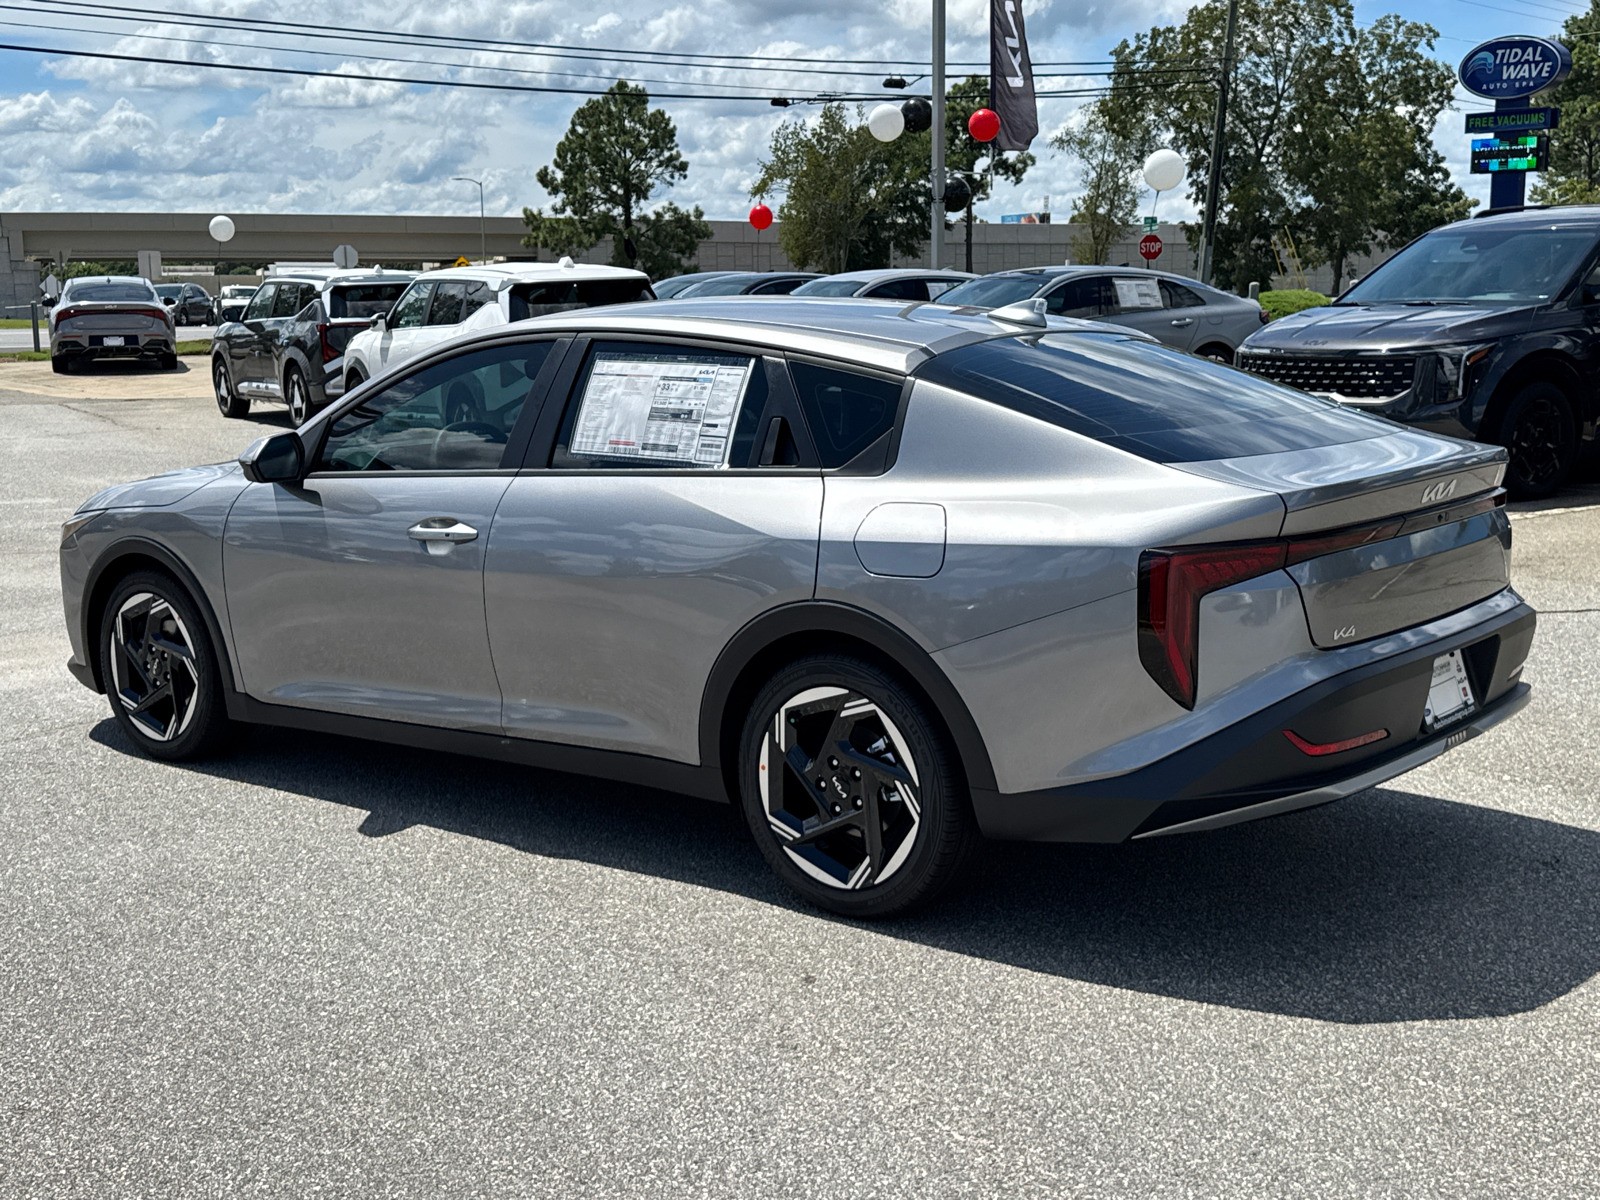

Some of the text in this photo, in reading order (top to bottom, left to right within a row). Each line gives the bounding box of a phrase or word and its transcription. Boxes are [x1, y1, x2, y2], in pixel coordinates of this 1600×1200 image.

[1495, 45, 1543, 65] TIDAL
[1502, 61, 1553, 80] WAVE
[1481, 82, 1508, 90] AUTO
[1468, 112, 1545, 128] FREE VACUUMS
[1140, 241, 1162, 254] STOP
[660, 382, 671, 391] 33
[1420, 478, 1457, 504] KIA
[1333, 624, 1356, 640] K4
